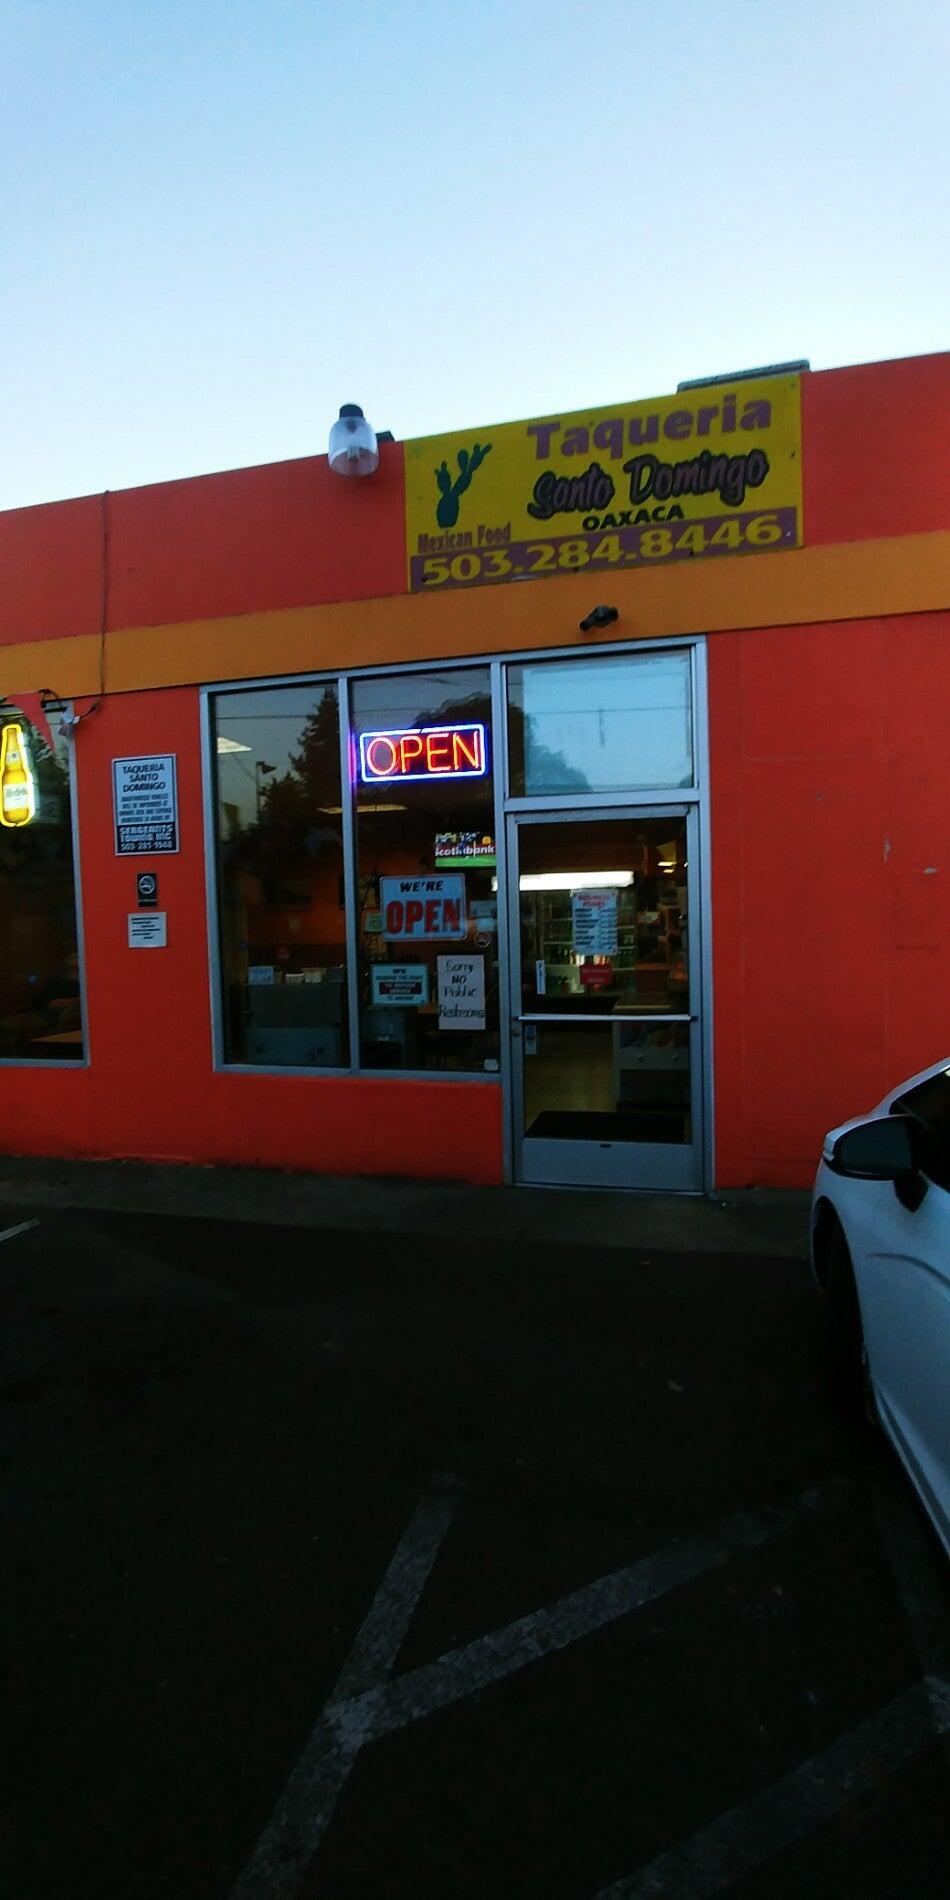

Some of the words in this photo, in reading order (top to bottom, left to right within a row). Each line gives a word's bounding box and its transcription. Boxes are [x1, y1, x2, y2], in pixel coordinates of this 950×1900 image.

[527, 395, 773, 460] Taqueria
[527, 462, 616, 521] Santo
[623, 448, 770, 507] Domingo
[582, 505, 685, 532] OAXACA
[417, 528, 474, 554] Mexican
[477, 521, 512, 547] Food
[422, 514, 783, 587] 503.284.8446
[366, 731, 480, 776] OPEN
[122, 763, 165, 774] TAQUERIA
[129, 773, 159, 783] SANTO
[123, 782, 166, 793] DOMINGO
[399, 880, 444, 893] WE'RE
[386, 898, 462, 935] OPEN
[445, 960, 474, 974] Sorry
[451, 974, 467, 984] NO
